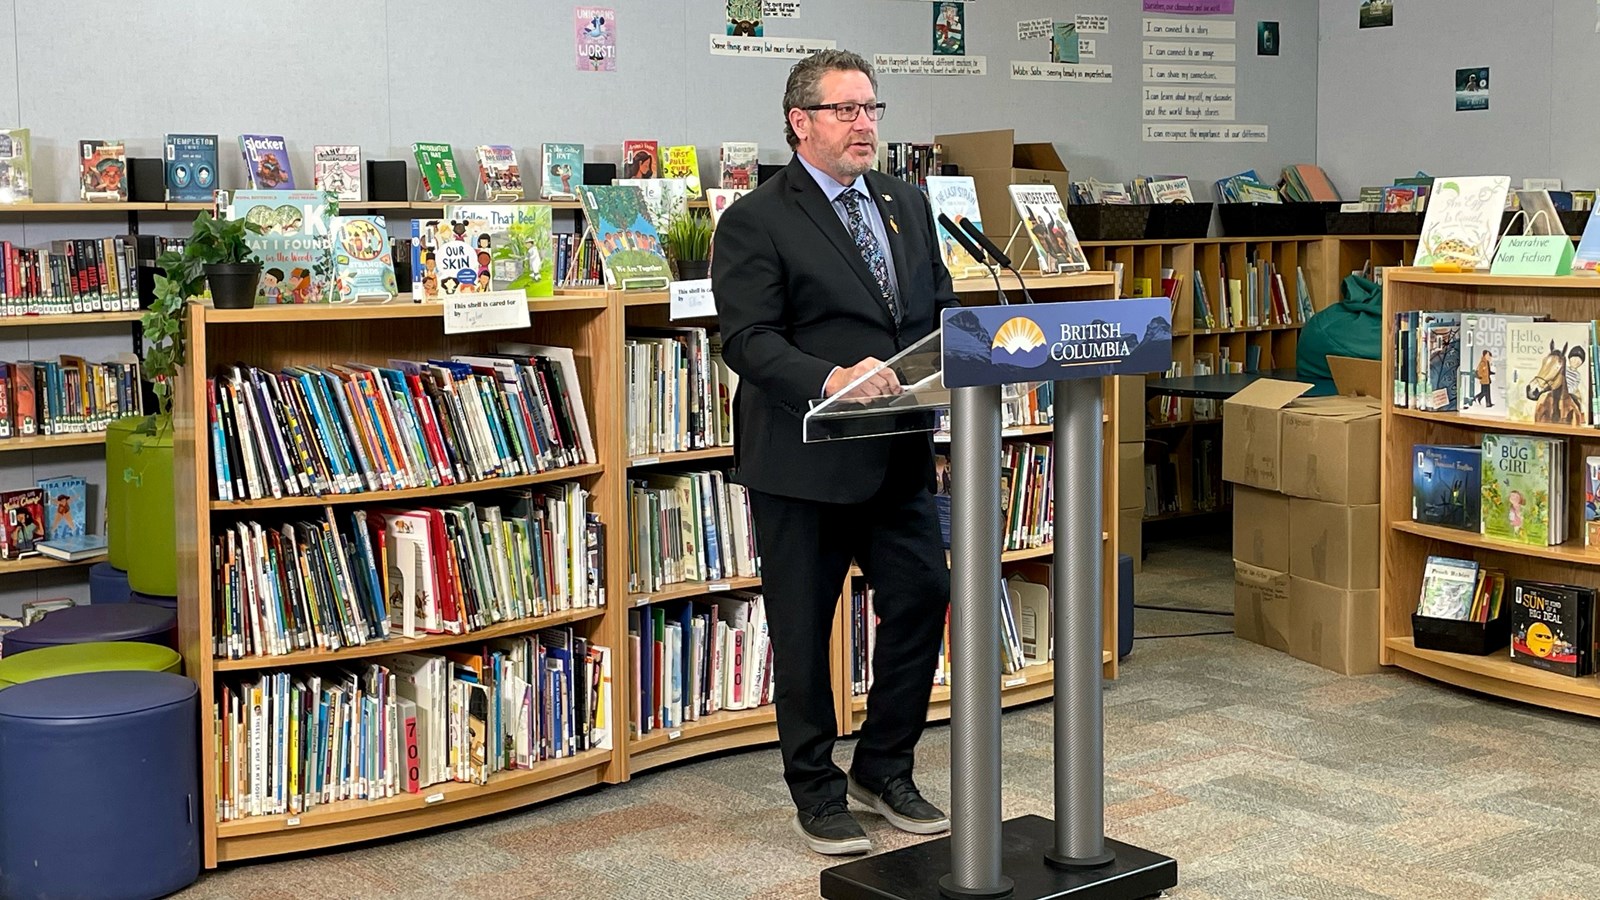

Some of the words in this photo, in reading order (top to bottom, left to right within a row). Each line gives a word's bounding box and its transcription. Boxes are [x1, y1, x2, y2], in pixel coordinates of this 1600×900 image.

[577, 9, 614, 20] UNICORNS
[1146, 21, 1151, 32] I
[579, 44, 615, 58] WORST!
[711, 39, 726, 50] Some
[764, 42, 772, 53] but
[786, 43, 795, 53] fun
[1148, 45, 1153, 55] I
[1149, 67, 1154, 77] I
[1167, 70, 1179, 78] share
[1181, 72, 1188, 80] my
[1145, 90, 1150, 100] I
[1160, 91, 1174, 101] learn
[1145, 107, 1155, 116] and
[1158, 106, 1166, 116] the
[1169, 106, 1183, 116] world
[1185, 106, 1202, 118] through
[1147, 127, 1152, 137] I
[1190, 128, 1198, 138] the
[173, 138, 214, 146] TEMPLETON
[245, 137, 284, 151] slacker
[556, 152, 570, 160] BAT
[944, 188, 957, 198] LAST
[462, 211, 488, 220] Follo
[490, 211, 514, 225] That
[518, 210, 536, 225] Bee!
[274, 239, 278, 250] I
[284, 239, 331, 250] FOUND
[1508, 238, 1550, 248] Narrative
[276, 251, 289, 263] the
[290, 251, 313, 263] Woods
[446, 246, 465, 257] OUR
[1497, 253, 1515, 264] Non
[1520, 251, 1552, 263] Fiction
[442, 256, 470, 271] SKIN
[638, 264, 663, 273] Together
[1479, 316, 1507, 332] OUR
[1060, 322, 1121, 342] BRITISH
[1511, 329, 1543, 343] Hello,
[1475, 331, 1506, 347] SUB
[1050, 341, 1131, 361] COLUMBIA
[1511, 341, 1544, 355] Horse
[1502, 445, 1528, 460] BUG
[1500, 459, 1531, 474] GIRL
[1522, 593, 1545, 611] SUN
[1529, 608, 1542, 619] BIG
[1543, 609, 1562, 624] DEAL
